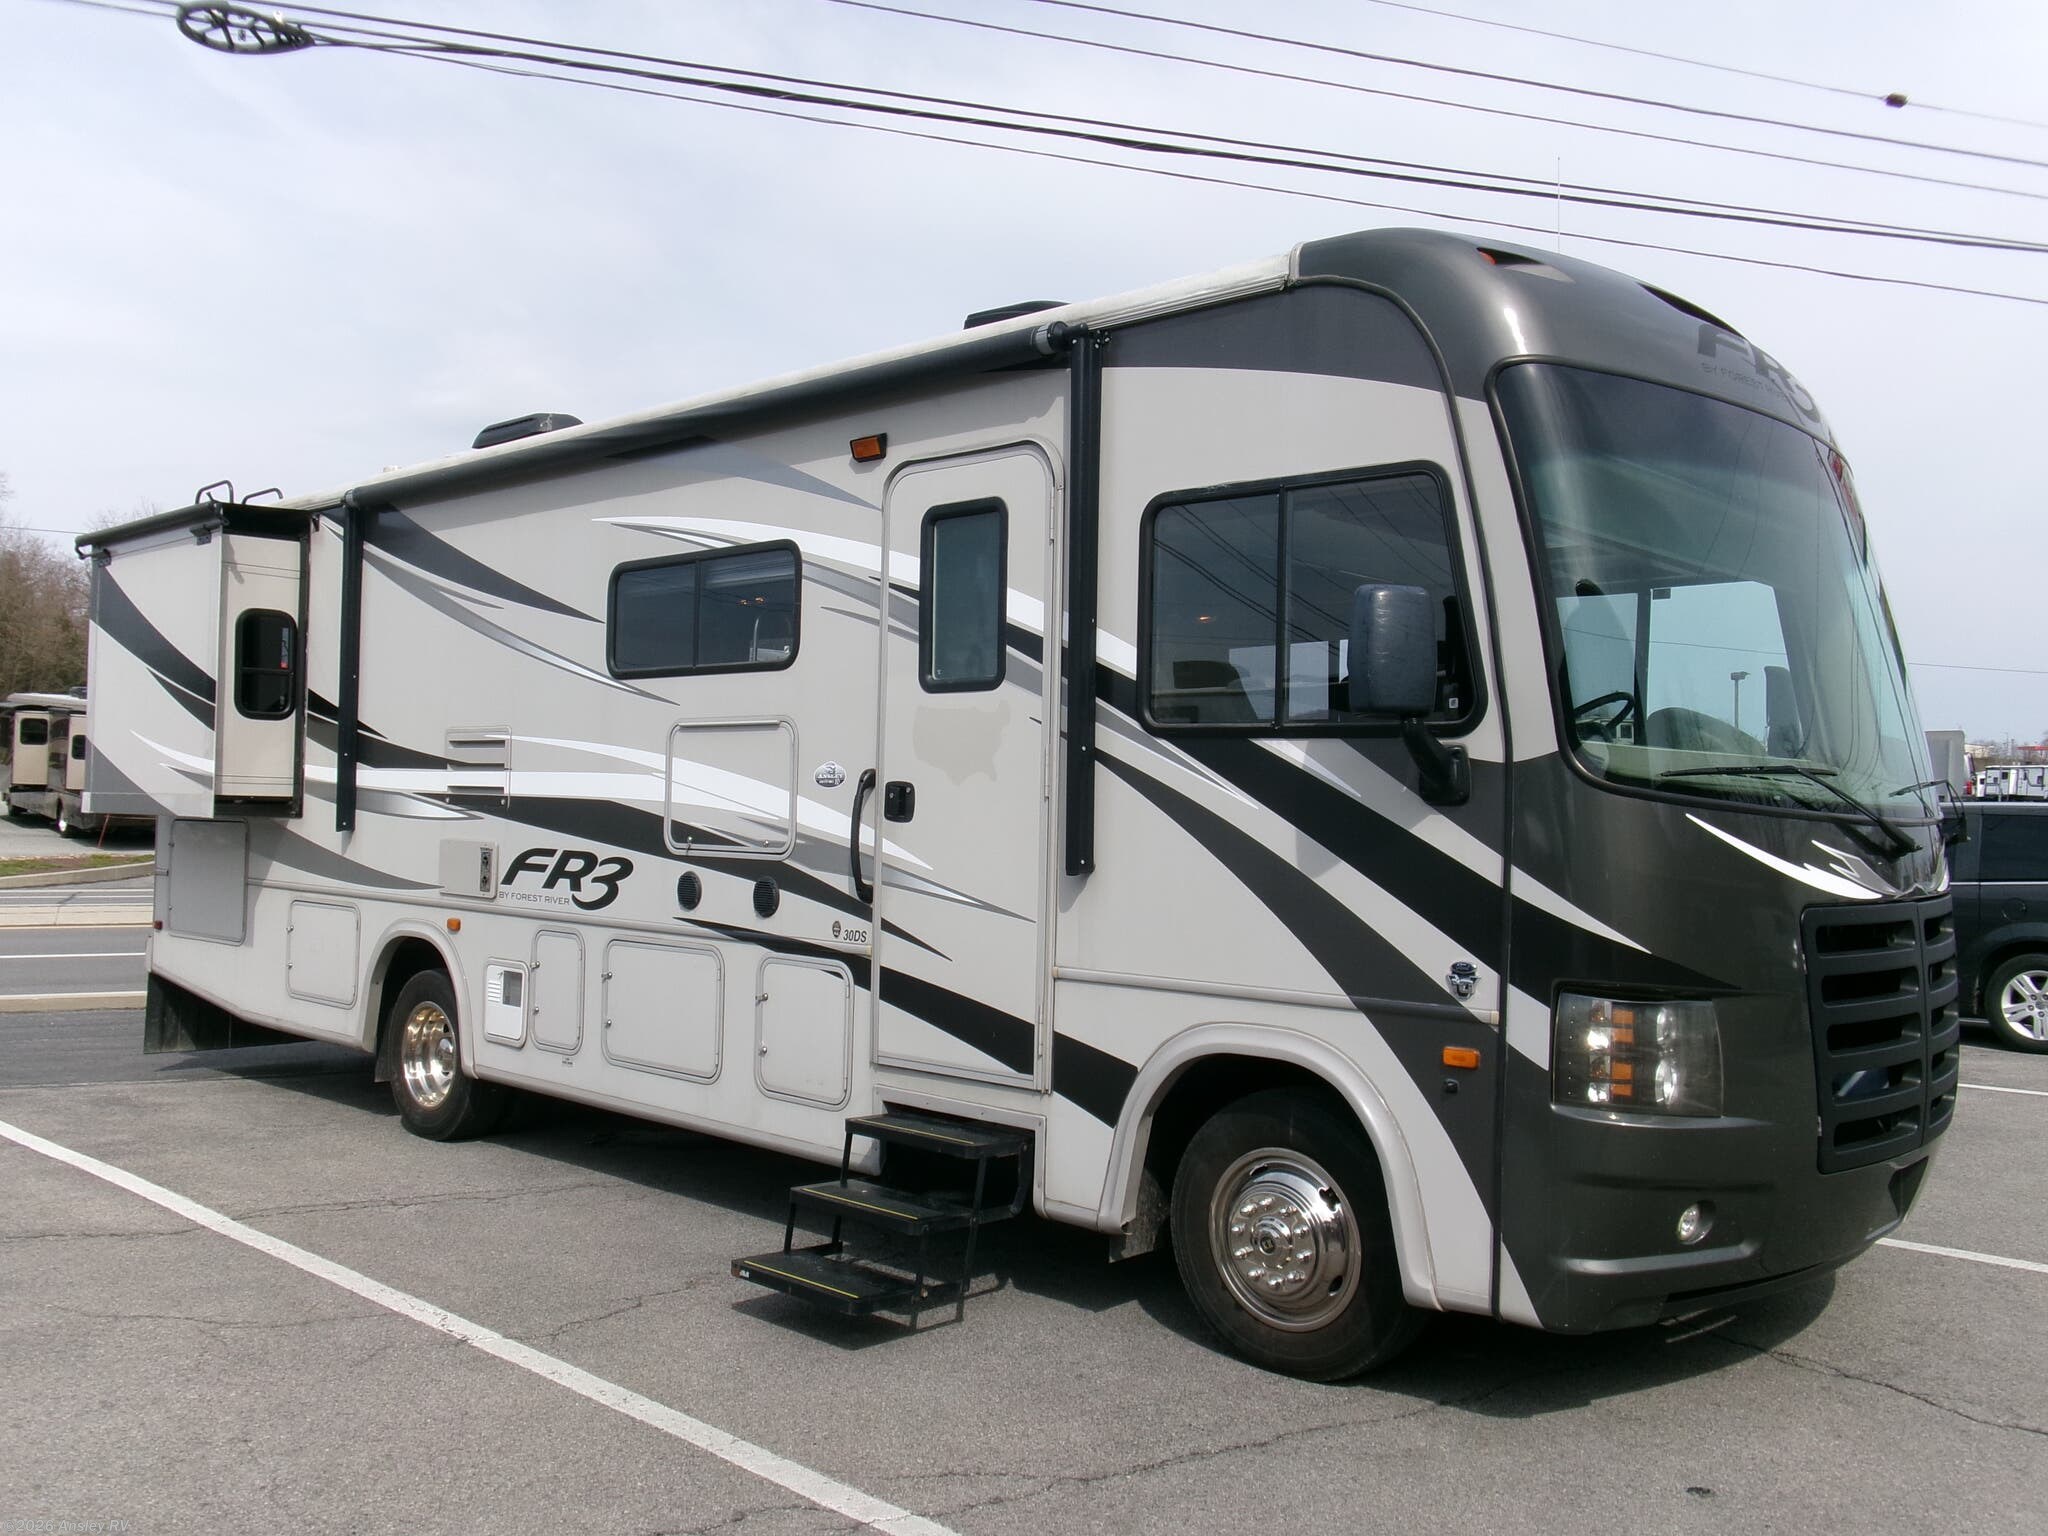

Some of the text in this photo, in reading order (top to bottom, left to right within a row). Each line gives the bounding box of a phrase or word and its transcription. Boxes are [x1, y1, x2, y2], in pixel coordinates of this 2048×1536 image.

[501, 848, 634, 911] FR3
[499, 891, 570, 905] BY FOREST RIVER
[843, 928, 868, 943] 30DS
